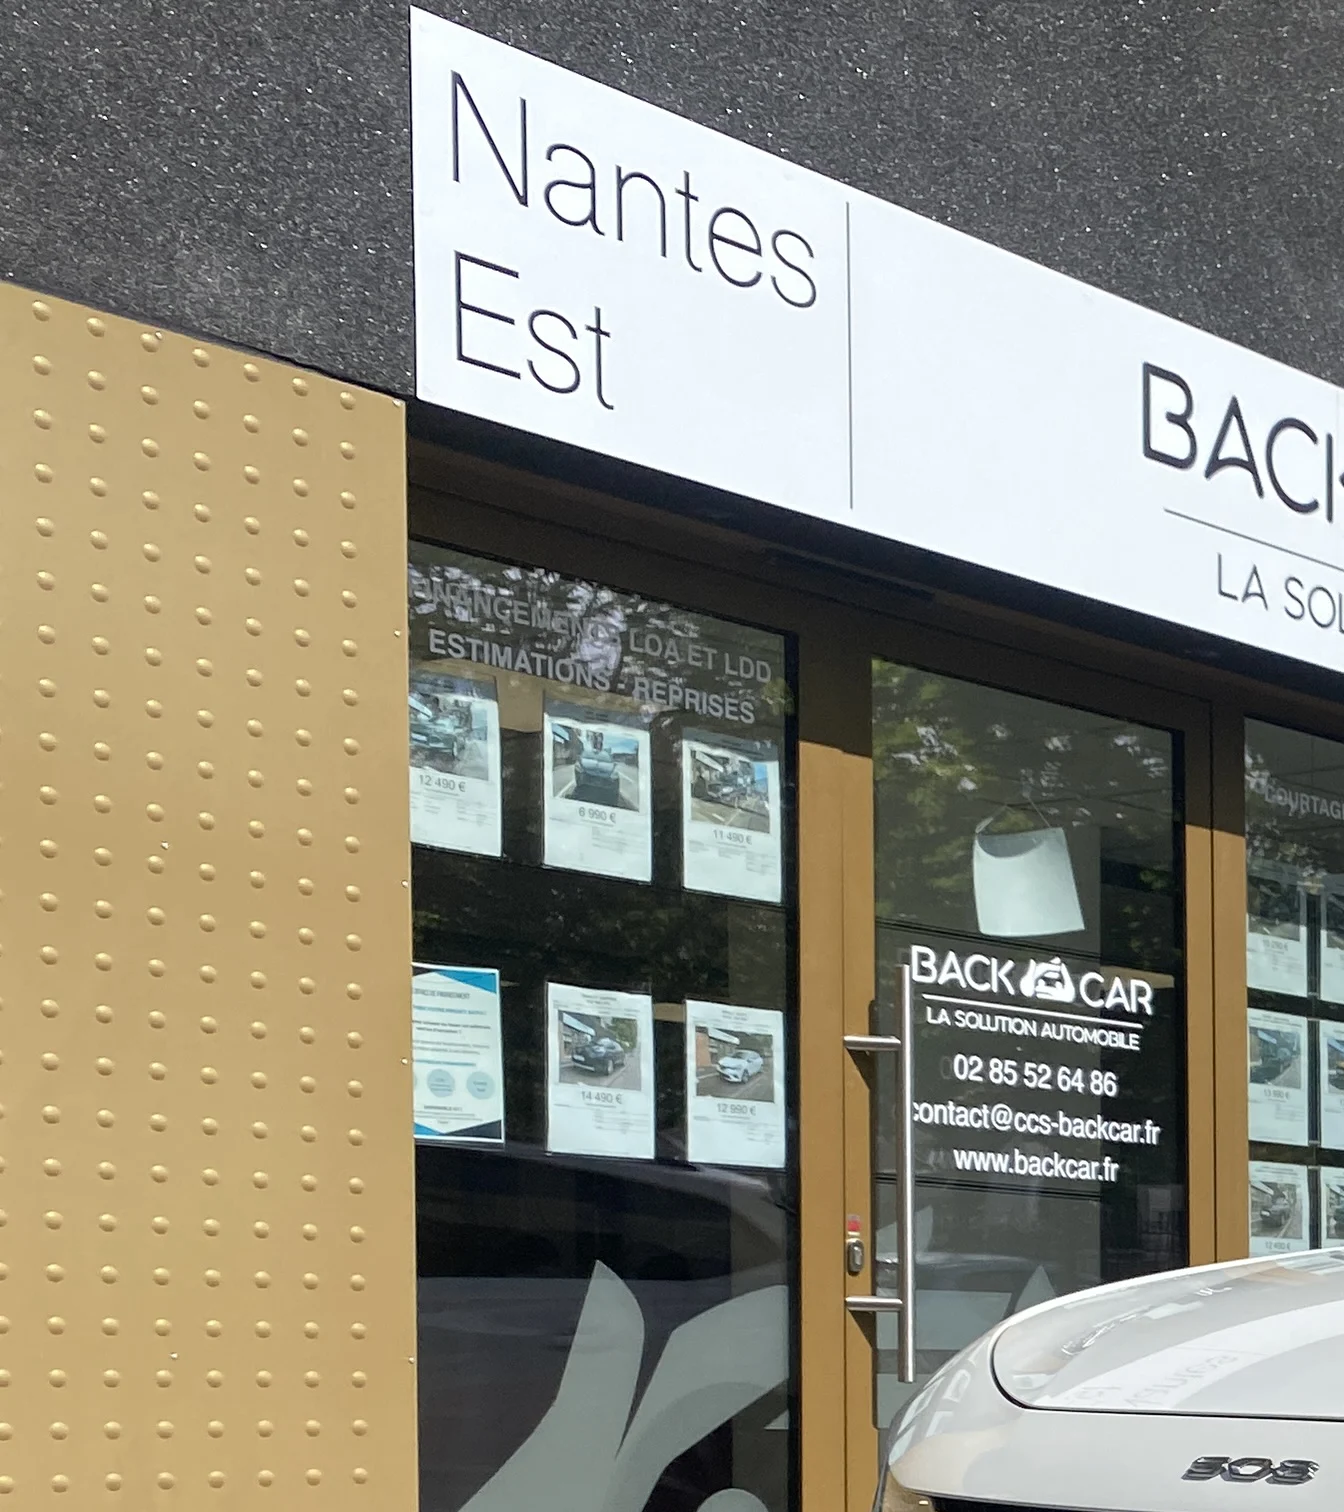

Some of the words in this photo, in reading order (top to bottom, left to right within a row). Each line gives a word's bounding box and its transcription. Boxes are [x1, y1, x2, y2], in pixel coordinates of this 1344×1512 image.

[450, 70, 817, 309] Nantes
[453, 250, 614, 411] Est
[1217, 552, 1270, 611] LA
[428, 628, 611, 692] ESTIMATIONS
[633, 676, 756, 725] REPRISES
[630, 627, 681, 664] LOA
[687, 644, 718, 670] ET
[724, 652, 772, 683] LDD
[419, 774, 433, 787] 12
[910, 945, 1016, 996] BACK
[1079, 971, 1154, 1016] CAR
[926, 1006, 952, 1026] LA
[954, 1009, 1037, 1037] SOLUTION
[1040, 1022, 1142, 1052] AUTOMOBILE
[953, 1053, 984, 1082] 02
[988, 1058, 1018, 1087] 85
[1023, 1062, 1052, 1090] 52
[1057, 1066, 1085, 1093] 64
[1089, 1070, 1118, 1098] 86
[953, 1148, 1120, 1183] www.backcar.fr
[1180, 1456, 1320, 1485] 508
